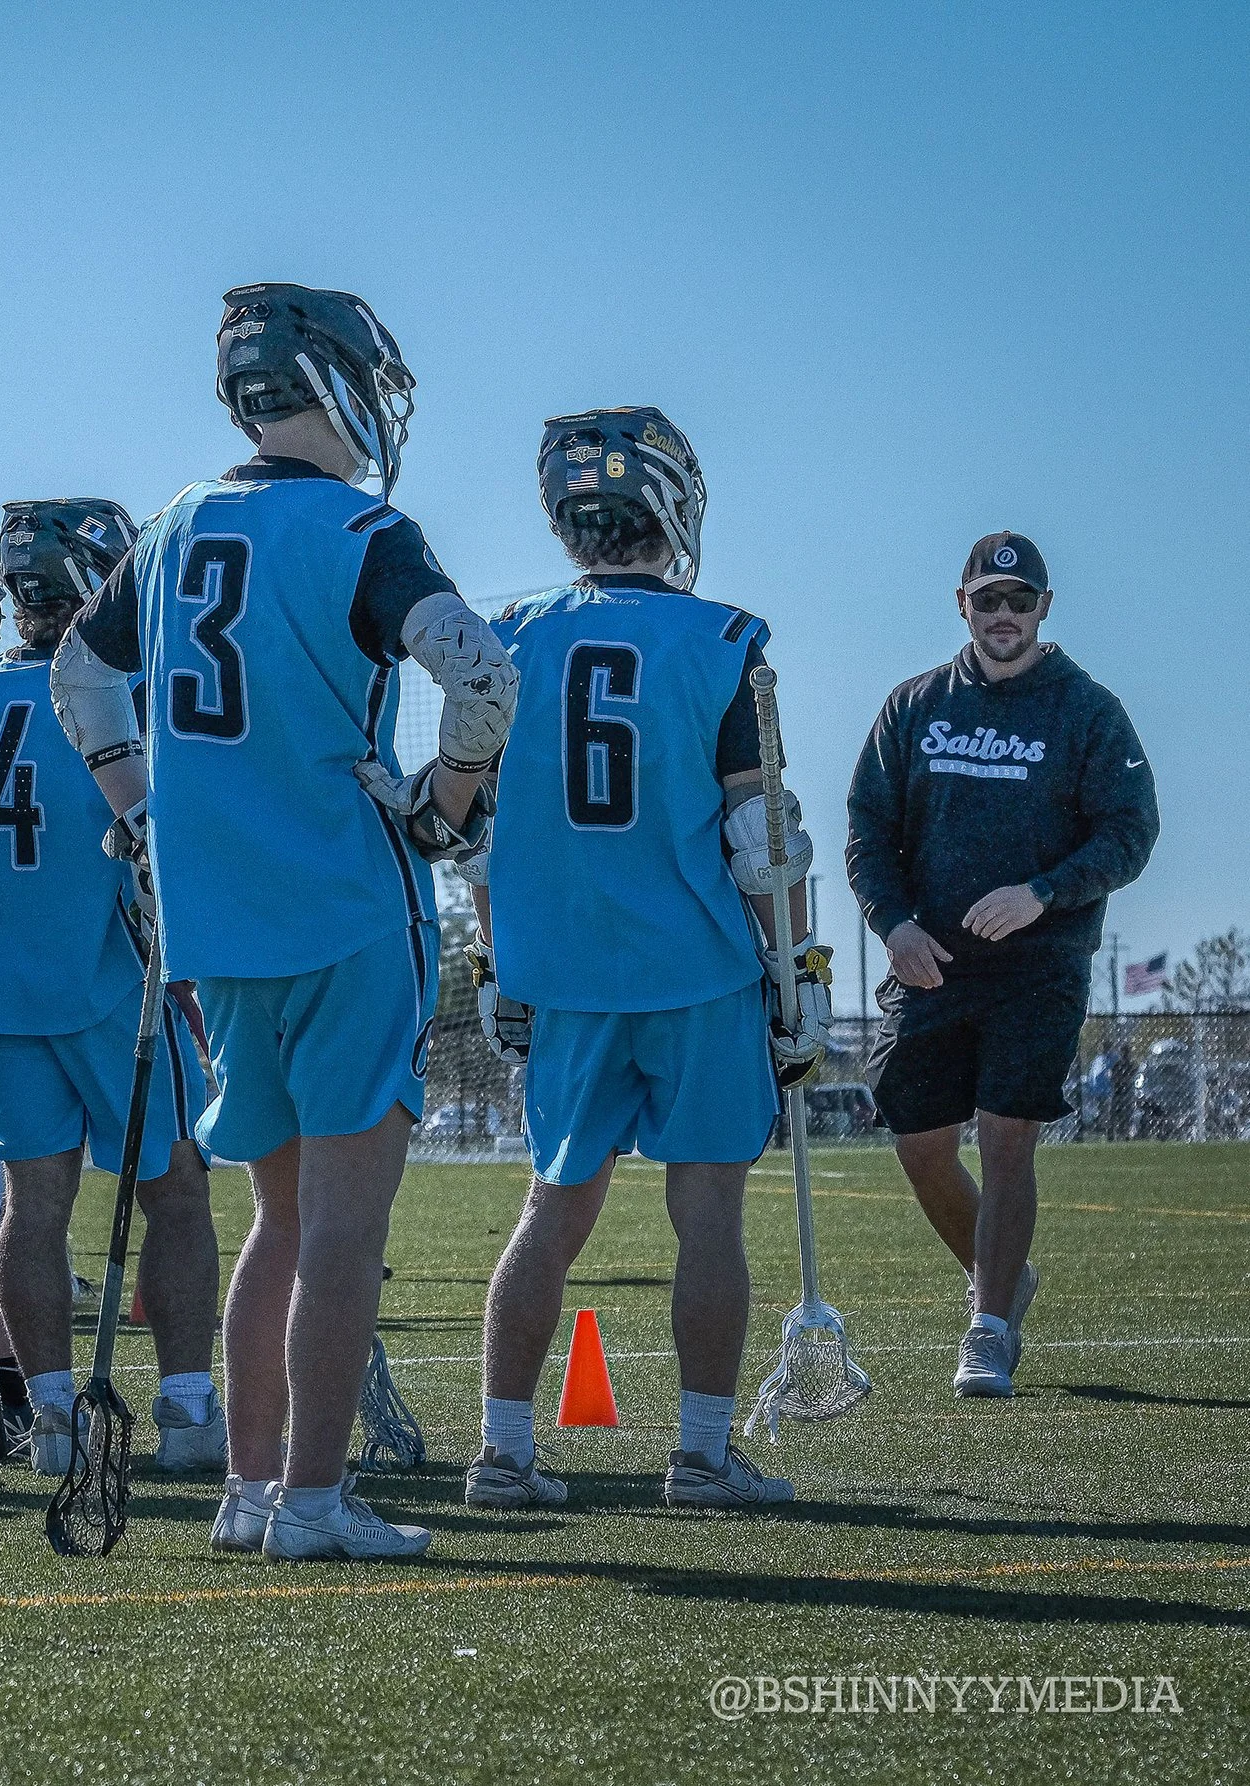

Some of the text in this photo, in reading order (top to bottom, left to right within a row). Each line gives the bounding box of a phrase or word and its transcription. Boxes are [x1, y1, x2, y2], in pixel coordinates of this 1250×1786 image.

[607, 452, 625, 478] 6
[168, 532, 253, 745] 3
[561, 638, 643, 832] 6
[920, 720, 1046, 762] Sailors
